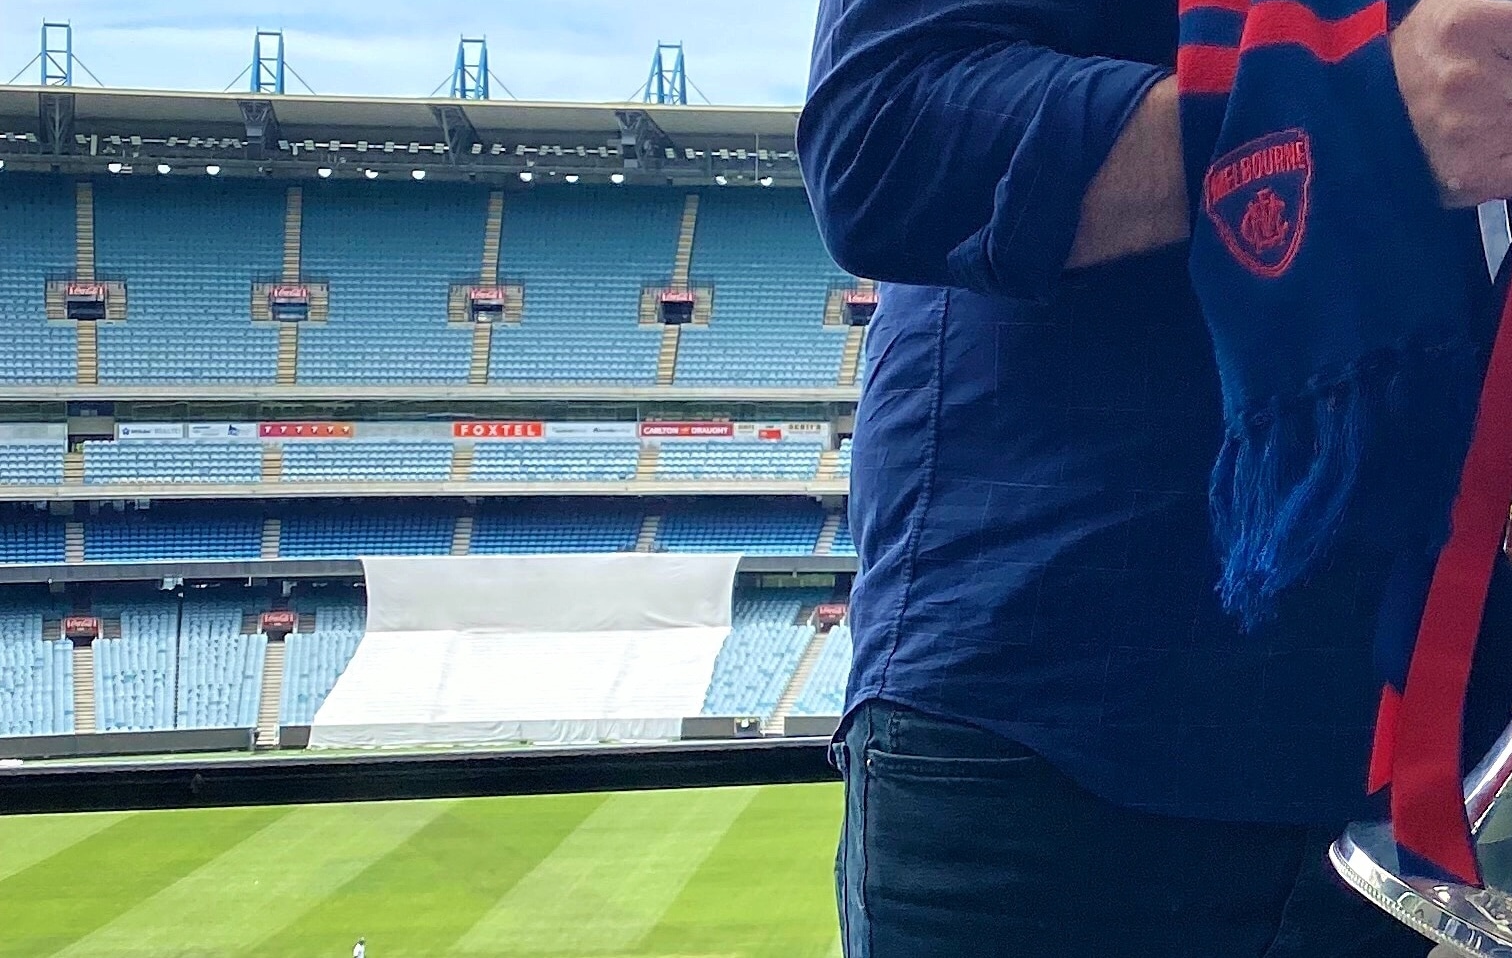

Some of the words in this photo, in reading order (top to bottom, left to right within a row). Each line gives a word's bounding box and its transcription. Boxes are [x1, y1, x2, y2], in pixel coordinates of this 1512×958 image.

[460, 424, 536, 436] FOXTEL
[643, 426, 679, 435] CARLTON
[691, 426, 729, 435] DRAUGHT
